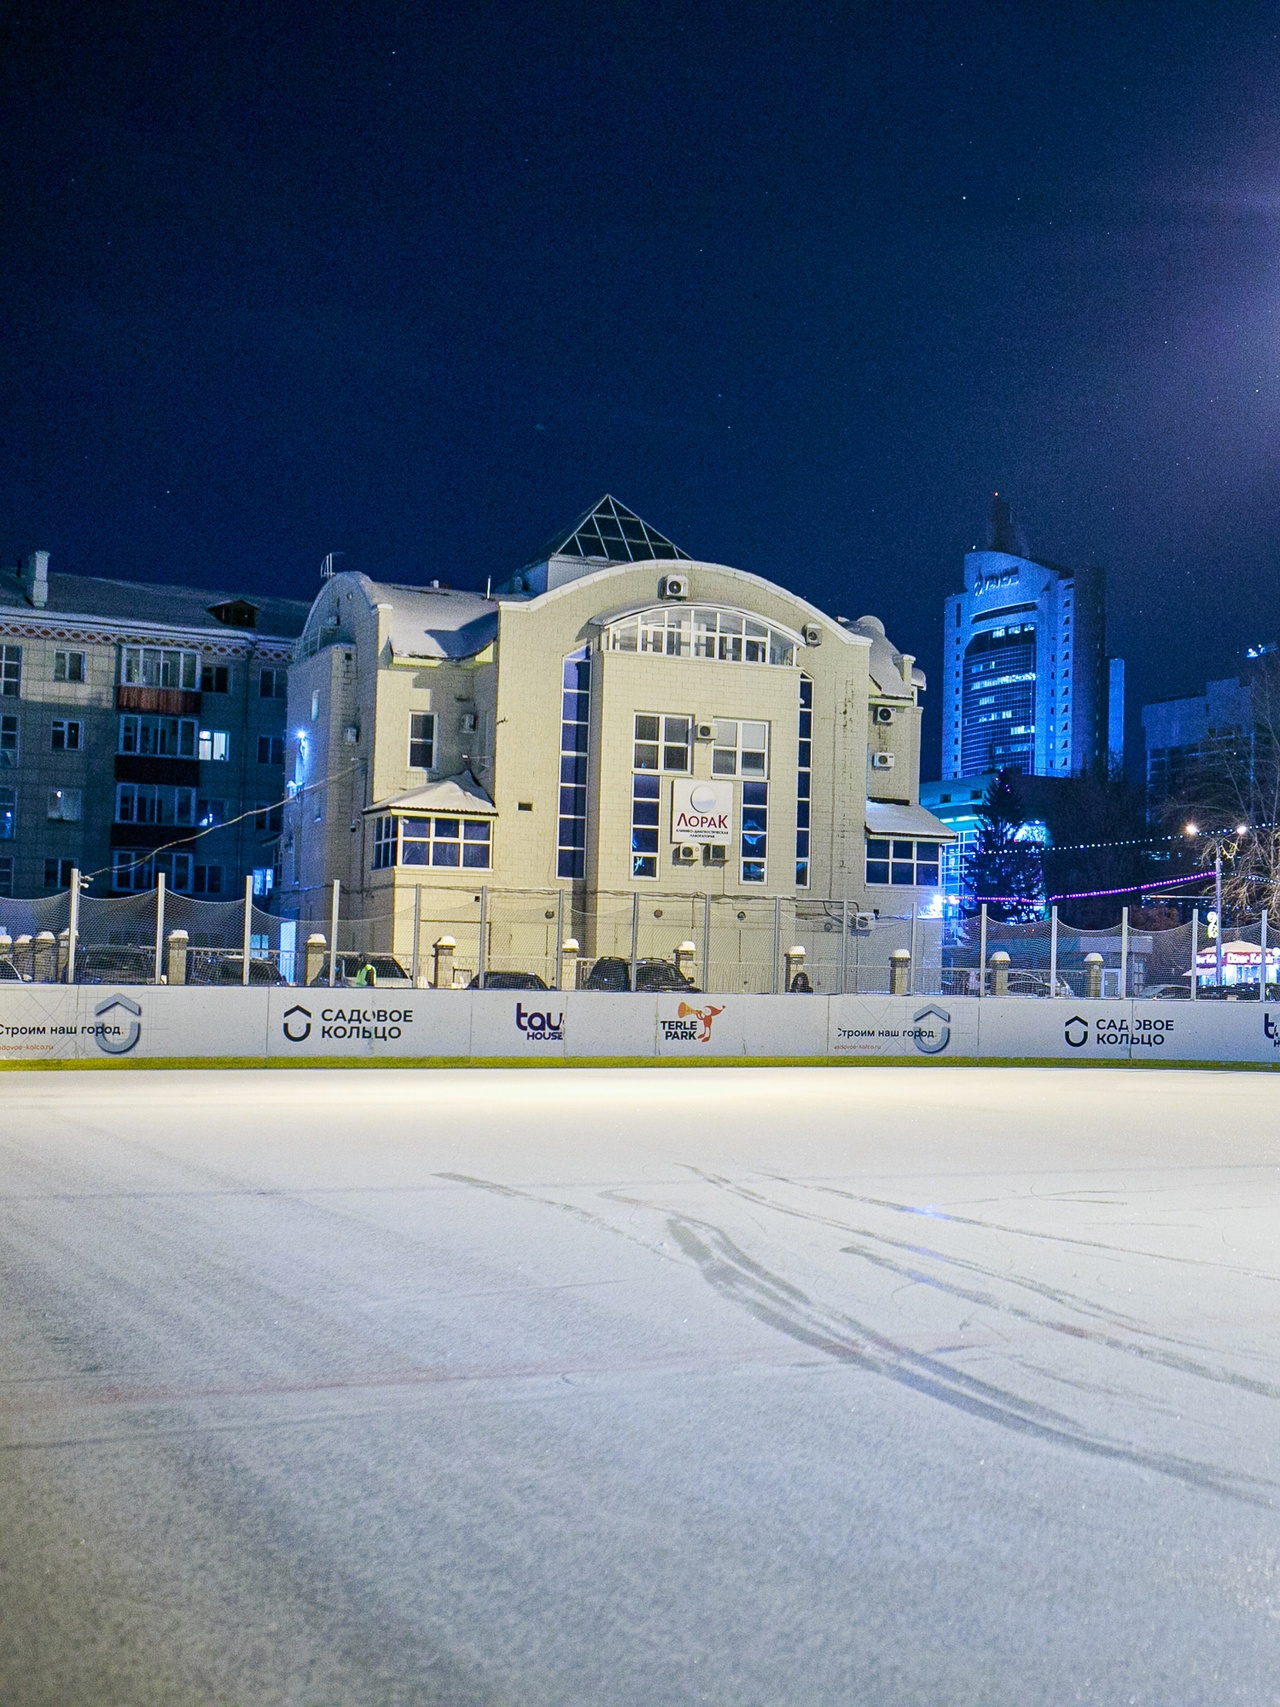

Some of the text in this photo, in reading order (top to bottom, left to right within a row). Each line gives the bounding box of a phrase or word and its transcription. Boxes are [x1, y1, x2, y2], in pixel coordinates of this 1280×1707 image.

[516, 1003, 564, 1031] tau
[50, 1026, 77, 1035] наш
[81, 1025, 124, 1038] город.
[660, 1021, 698, 1031] TERLE
[321, 1026, 402, 1041] КОЛЬЦО
[527, 1032, 563, 1040] HOUSE
[665, 1031, 697, 1041] PARK
[1096, 1033, 1165, 1047] КОЛЬЦО
